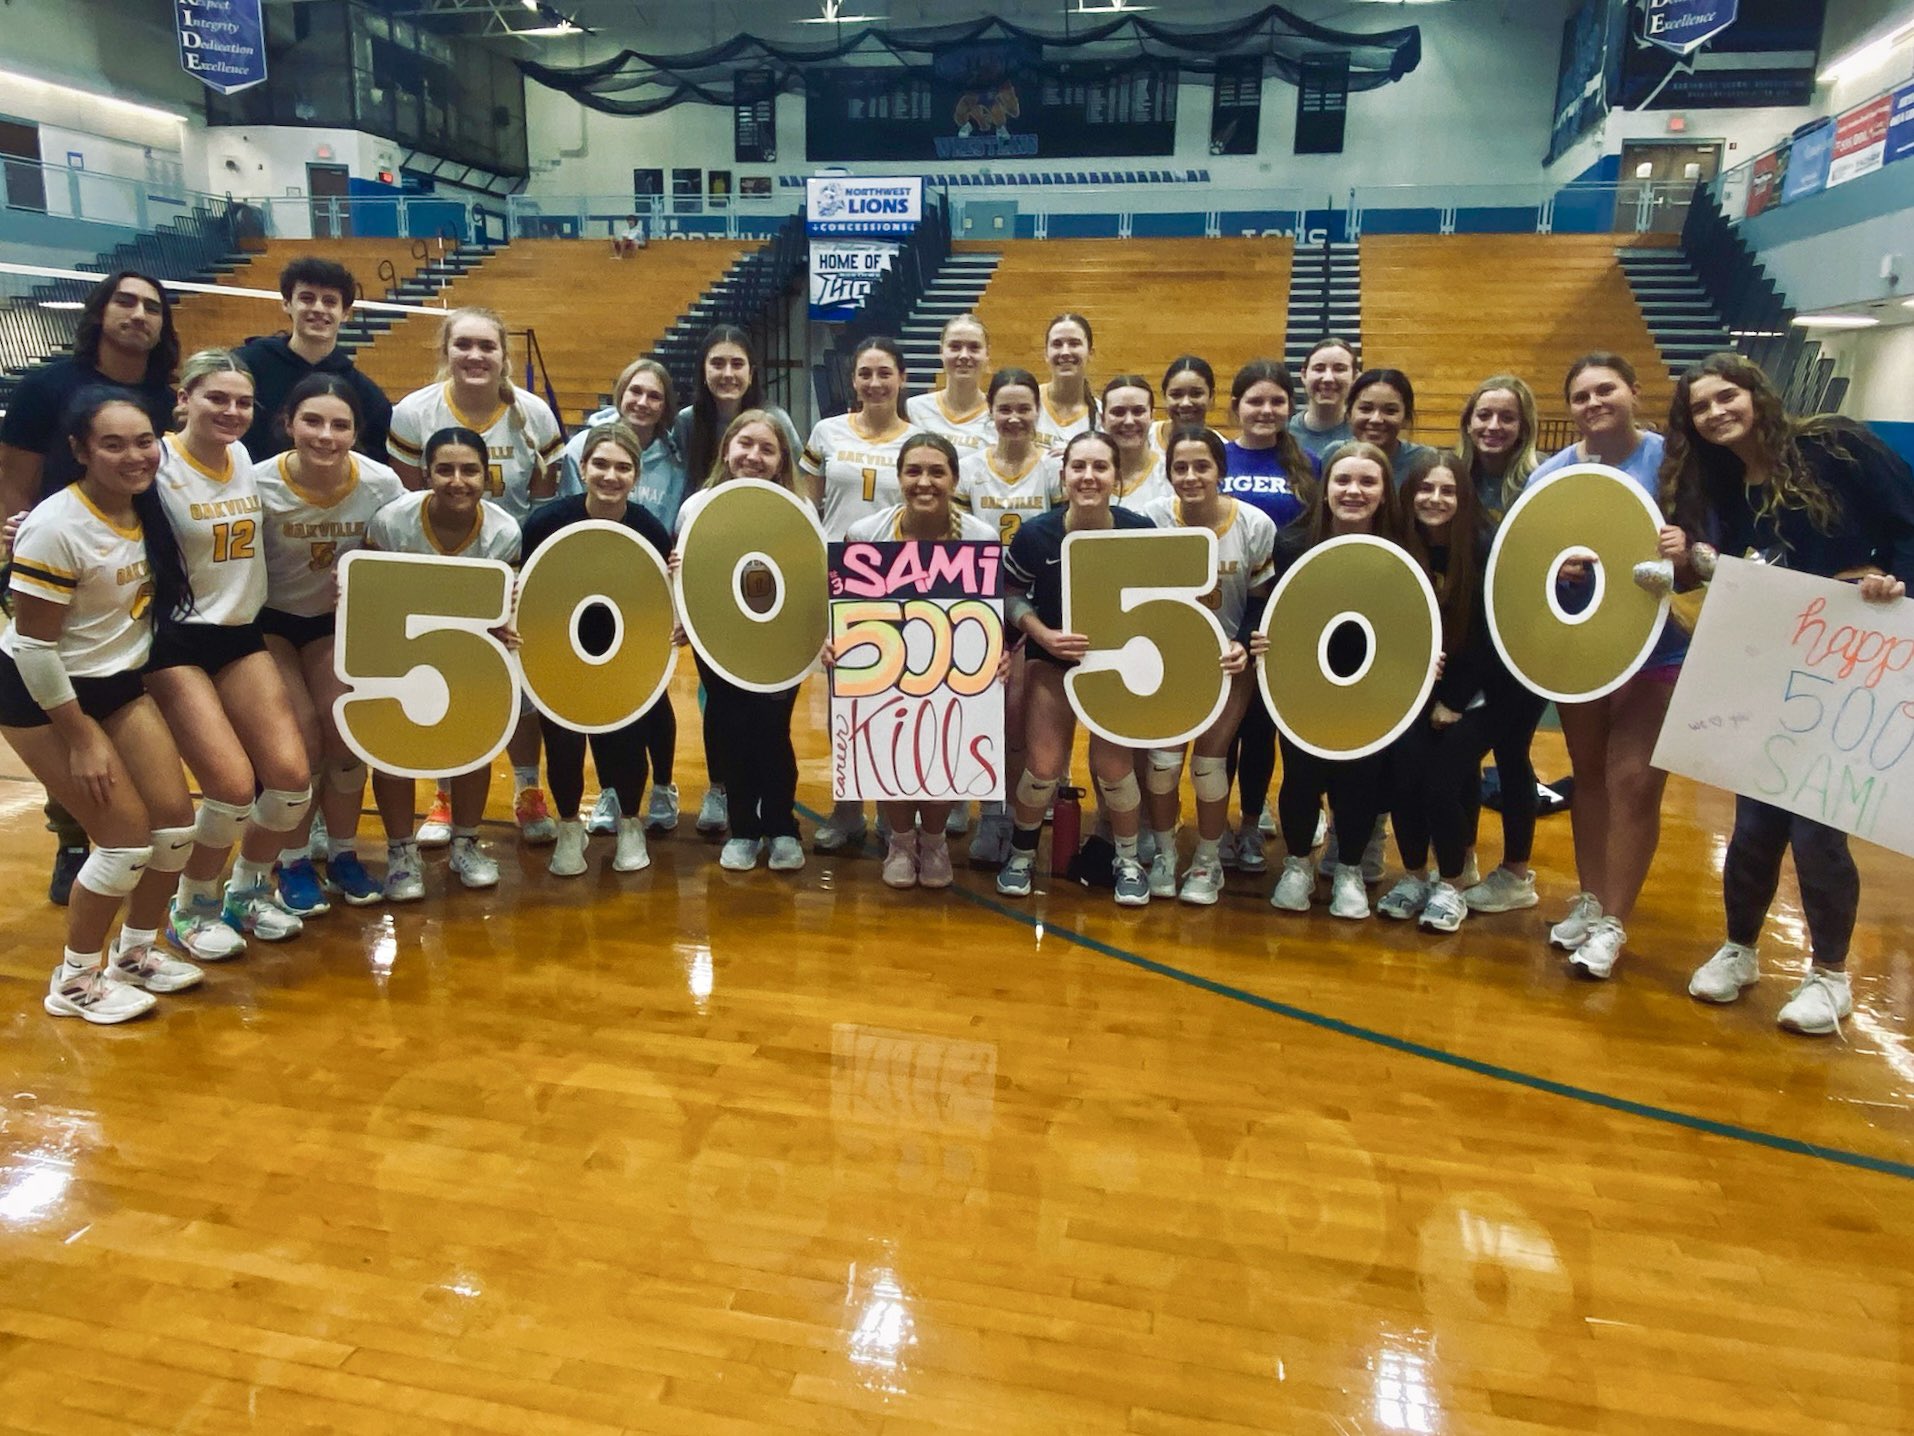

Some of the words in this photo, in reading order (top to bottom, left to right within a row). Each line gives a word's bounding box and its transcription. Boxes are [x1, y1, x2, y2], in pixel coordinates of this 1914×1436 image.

[182, 9, 239, 34] Integrity
[1649, 11, 1716, 34] Excellence
[181, 31, 254, 55] Dedication
[185, 52, 249, 75] Excellence
[845, 187, 912, 196] NORTHWEST
[848, 199, 908, 214] LIONS
[820, 223, 907, 232] CONCESSIONS
[819, 254, 858, 269] HOME
[865, 254, 881, 269] OF
[837, 450, 897, 467] OAKVILL
[861, 468, 877, 501] 1
[1217, 475, 1293, 494] IGER
[981, 496, 1043, 509] OAKVILLE
[213, 519, 256, 563] 12
[283, 522, 365, 538] OAKVILLE
[1000, 513, 1021, 546] 2
[831, 598, 1004, 698] 500
[1780, 670, 1914, 771] 500
[835, 714, 850, 798] career
[849, 696, 997, 799] Kills
[1754, 734, 1889, 837] SAMI
